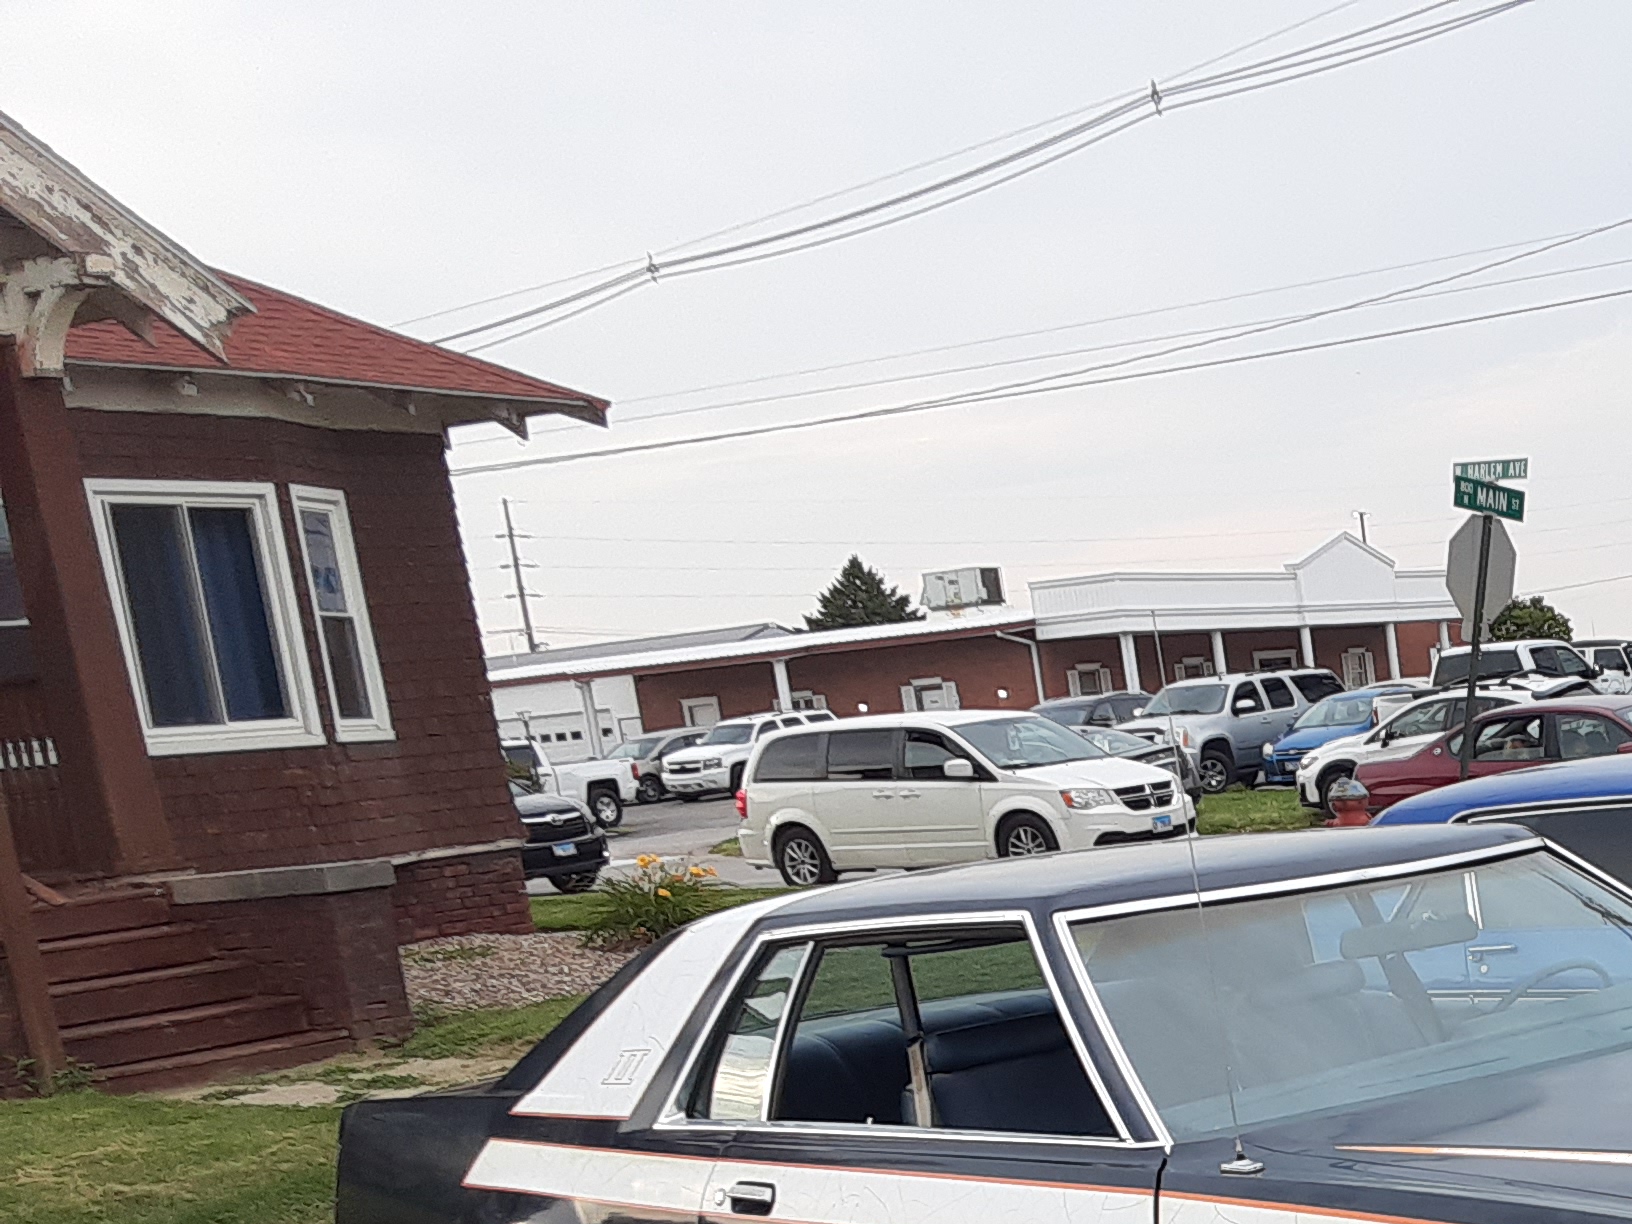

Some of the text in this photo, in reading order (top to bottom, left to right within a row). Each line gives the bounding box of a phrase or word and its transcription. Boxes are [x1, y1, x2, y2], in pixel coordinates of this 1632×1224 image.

[1467, 462, 1503, 480] HARLEM
[1508, 461, 1526, 477] AVE
[1477, 485, 1507, 512] MAIN
[1511, 498, 1519, 510] ST
